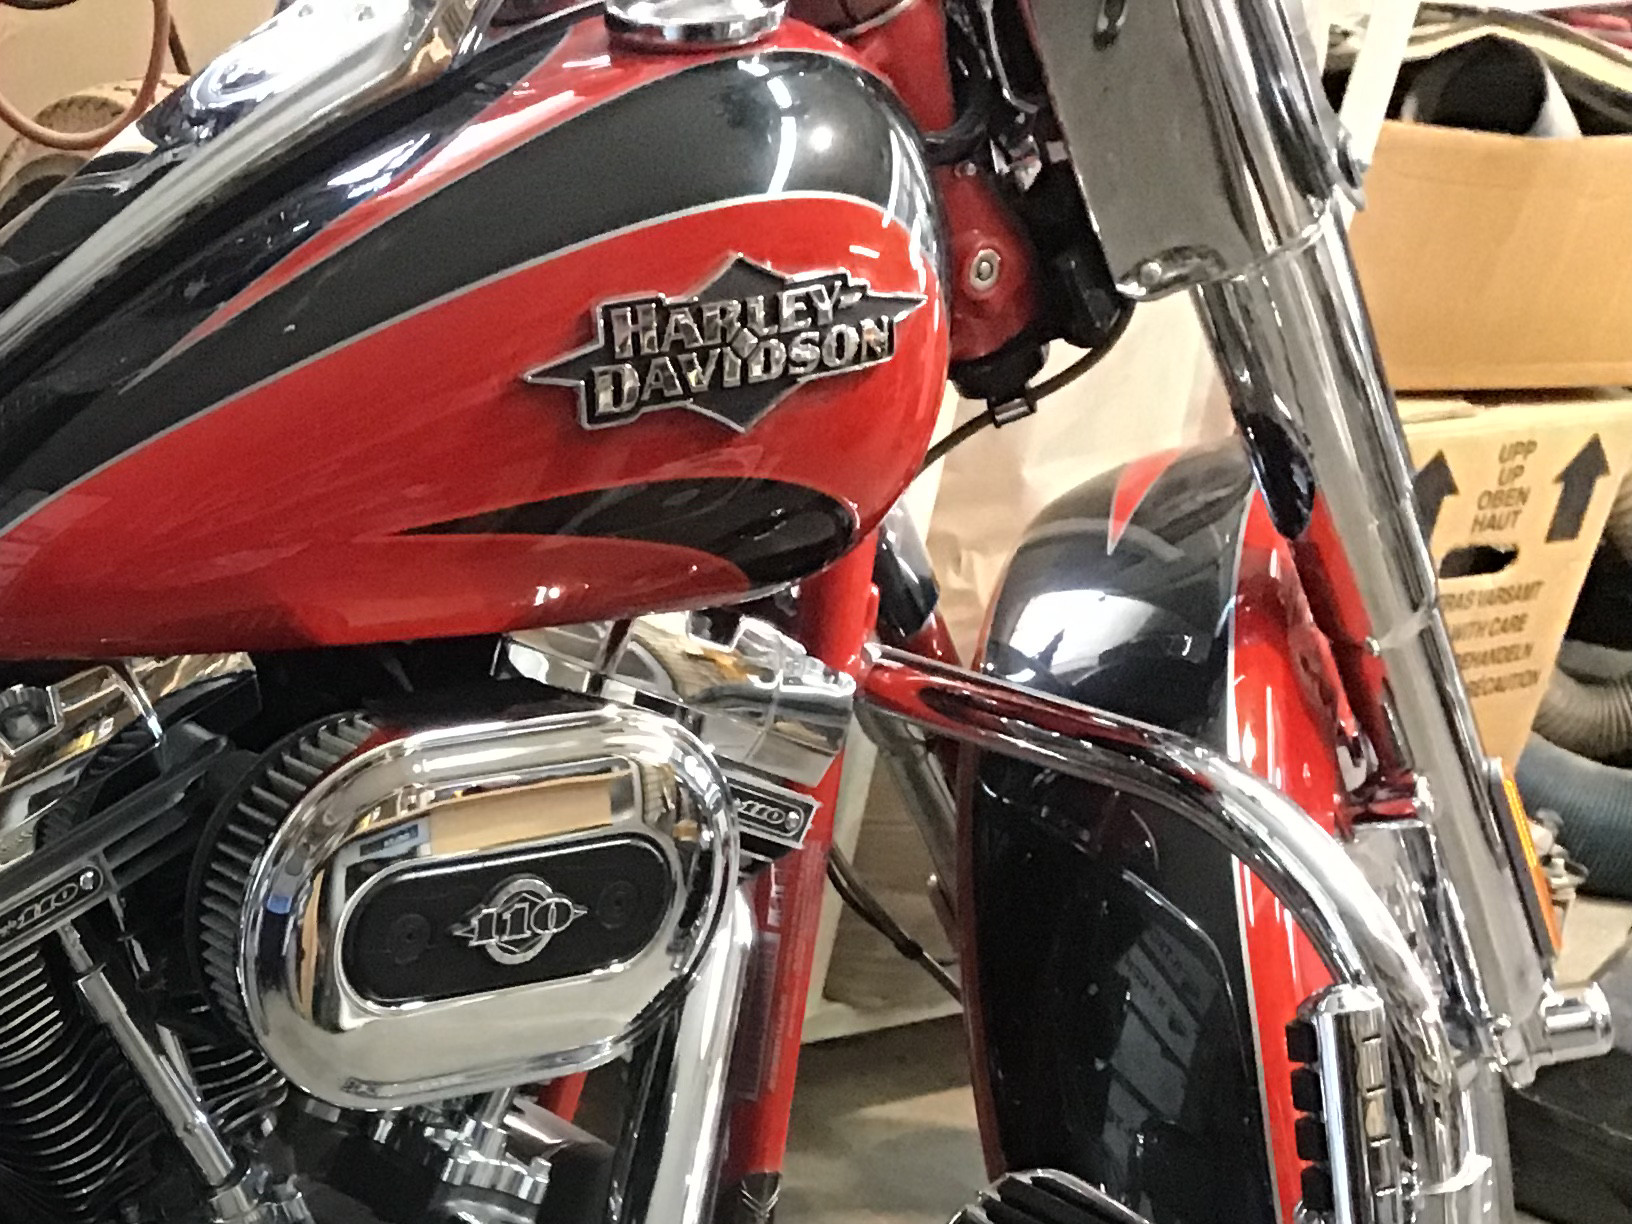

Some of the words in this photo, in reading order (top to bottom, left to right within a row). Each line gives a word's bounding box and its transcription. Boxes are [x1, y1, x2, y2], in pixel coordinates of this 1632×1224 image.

[590, 316, 895, 416] DAVIDSON
[1498, 439, 1538, 464] UPP
[1498, 464, 1525, 486] UP
[1477, 487, 1531, 511] OBEN
[1471, 509, 1523, 535] HAUT
[18, 883, 79, 930] 110
[469, 897, 574, 946] 110
